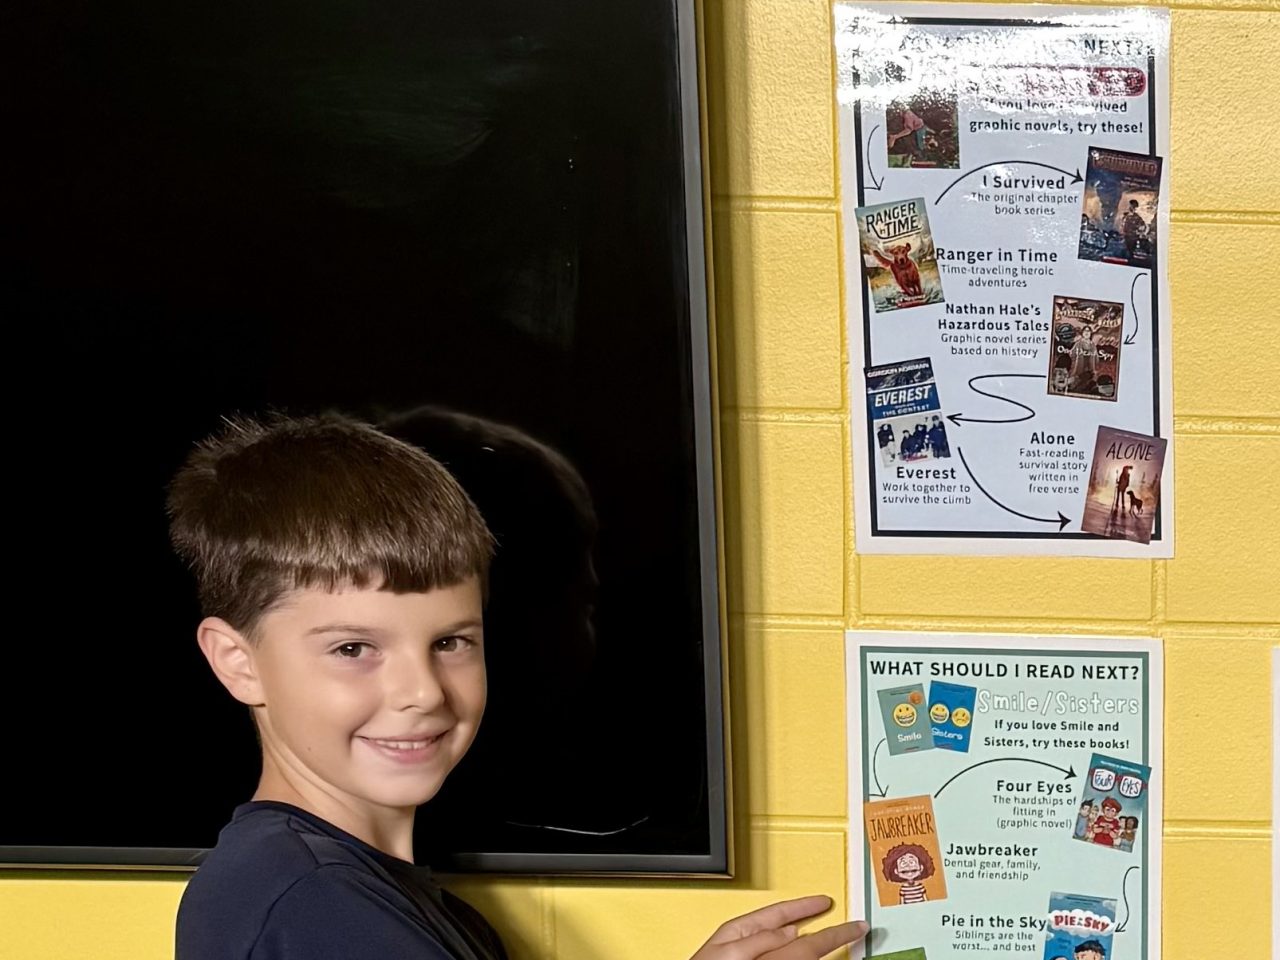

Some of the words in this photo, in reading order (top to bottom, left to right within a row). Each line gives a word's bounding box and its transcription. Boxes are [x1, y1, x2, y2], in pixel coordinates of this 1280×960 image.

[1078, 122, 1097, 134] try
[1102, 122, 1143, 133] these!
[984, 176, 987, 187] I
[994, 176, 1064, 189] Survived
[993, 193, 1033, 205] original
[1038, 193, 1077, 205] chapter
[995, 205, 1021, 215] book
[1025, 206, 1055, 215] series
[866, 202, 916, 232] RANGER
[886, 215, 920, 237] TIME
[936, 248, 991, 264] Ranger
[999, 249, 1012, 261] in
[1019, 250, 1057, 262] Time
[946, 304, 994, 315] Nathan
[1000, 305, 1040, 316] Hale's
[938, 320, 1010, 331] Hazardous
[1015, 321, 1049, 331] Tales
[951, 347, 981, 355] based
[1002, 347, 1037, 358] history
[875, 385, 931, 408] EVEREST
[1031, 433, 1075, 444] Alone
[1106, 443, 1153, 461] ALONE
[897, 467, 956, 480] Everest
[883, 483, 909, 492] Work
[913, 483, 956, 494] together
[960, 485, 970, 493] to
[871, 661, 923, 675] WHAT
[931, 662, 1007, 677] SHOULD
[1015, 663, 1018, 677] I
[1027, 665, 1075, 678] READ
[1082, 666, 1139, 680] NEXT?
[978, 690, 1139, 715] Smile/Sisters
[995, 720, 1002, 730] If
[1006, 722, 1027, 733] you
[1032, 721, 1056, 730] love
[1061, 721, 1094, 731] Smile
[1098, 722, 1119, 731] and
[898, 732, 921, 742] Smile
[932, 727, 963, 740] Sisters
[984, 737, 1029, 748] Sisters,
[1032, 738, 1050, 749] try
[1054, 738, 1086, 748] these
[1090, 738, 1129, 749] books!
[997, 781, 1032, 792] Four
[1037, 781, 1072, 794] Eyes
[870, 812, 934, 842] JAWBREAKER
[947, 843, 1038, 856] Jawbreaker
[942, 915, 965, 926] Pie
[970, 916, 984, 927] in
[990, 916, 1014, 928] the
[1020, 916, 1046, 932] Sky
